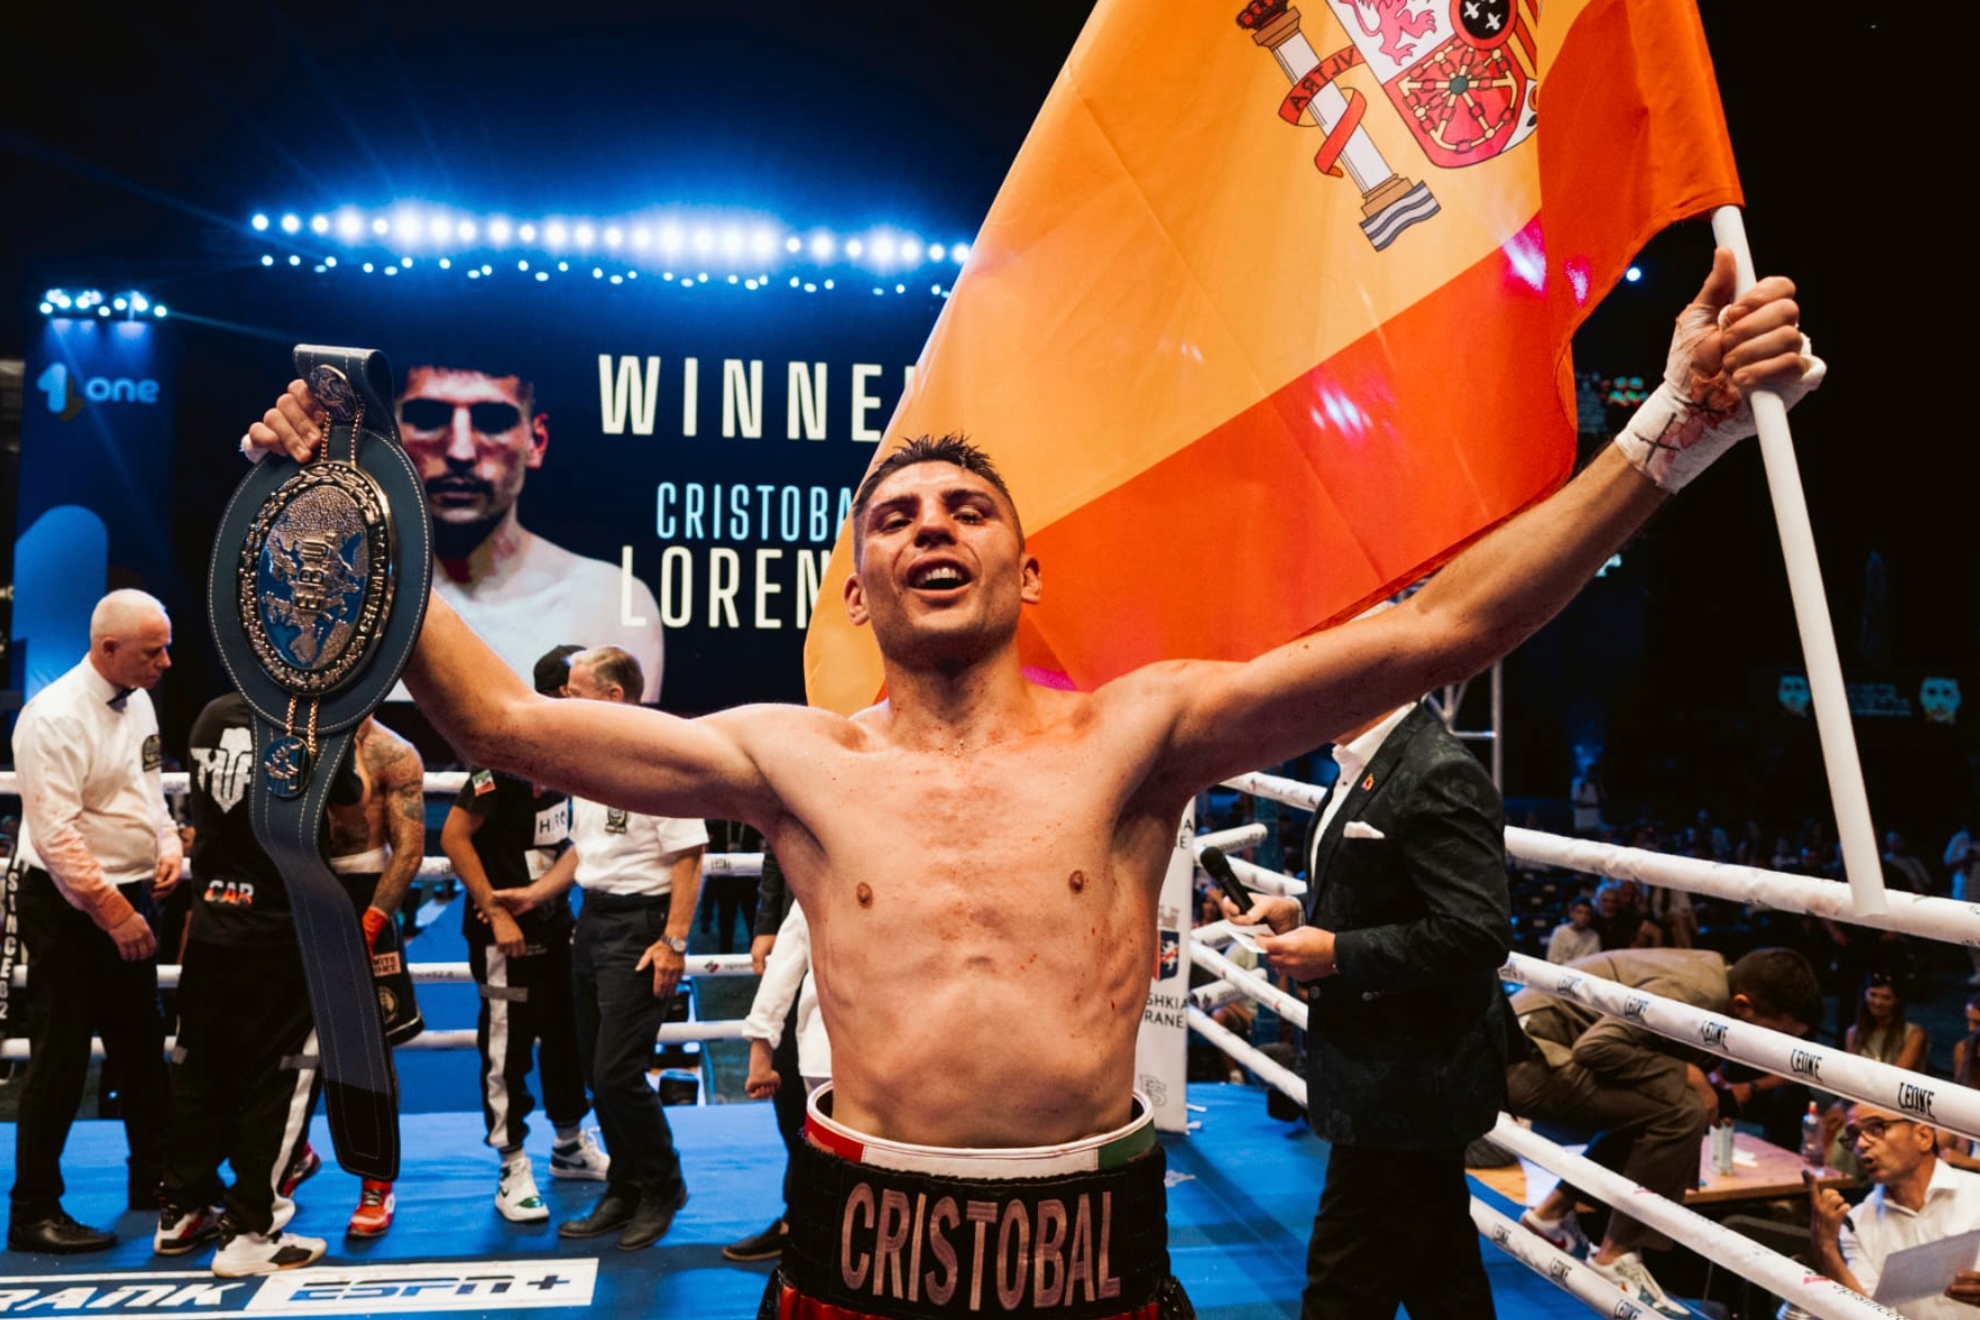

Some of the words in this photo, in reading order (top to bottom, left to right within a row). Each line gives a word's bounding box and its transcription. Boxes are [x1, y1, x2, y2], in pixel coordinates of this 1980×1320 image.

[85, 376, 160, 404] one
[598, 353, 917, 443] WINNE
[1898, 1082, 1936, 1119] LEONE
[841, 1182, 1121, 1311] CRISTOBAL
